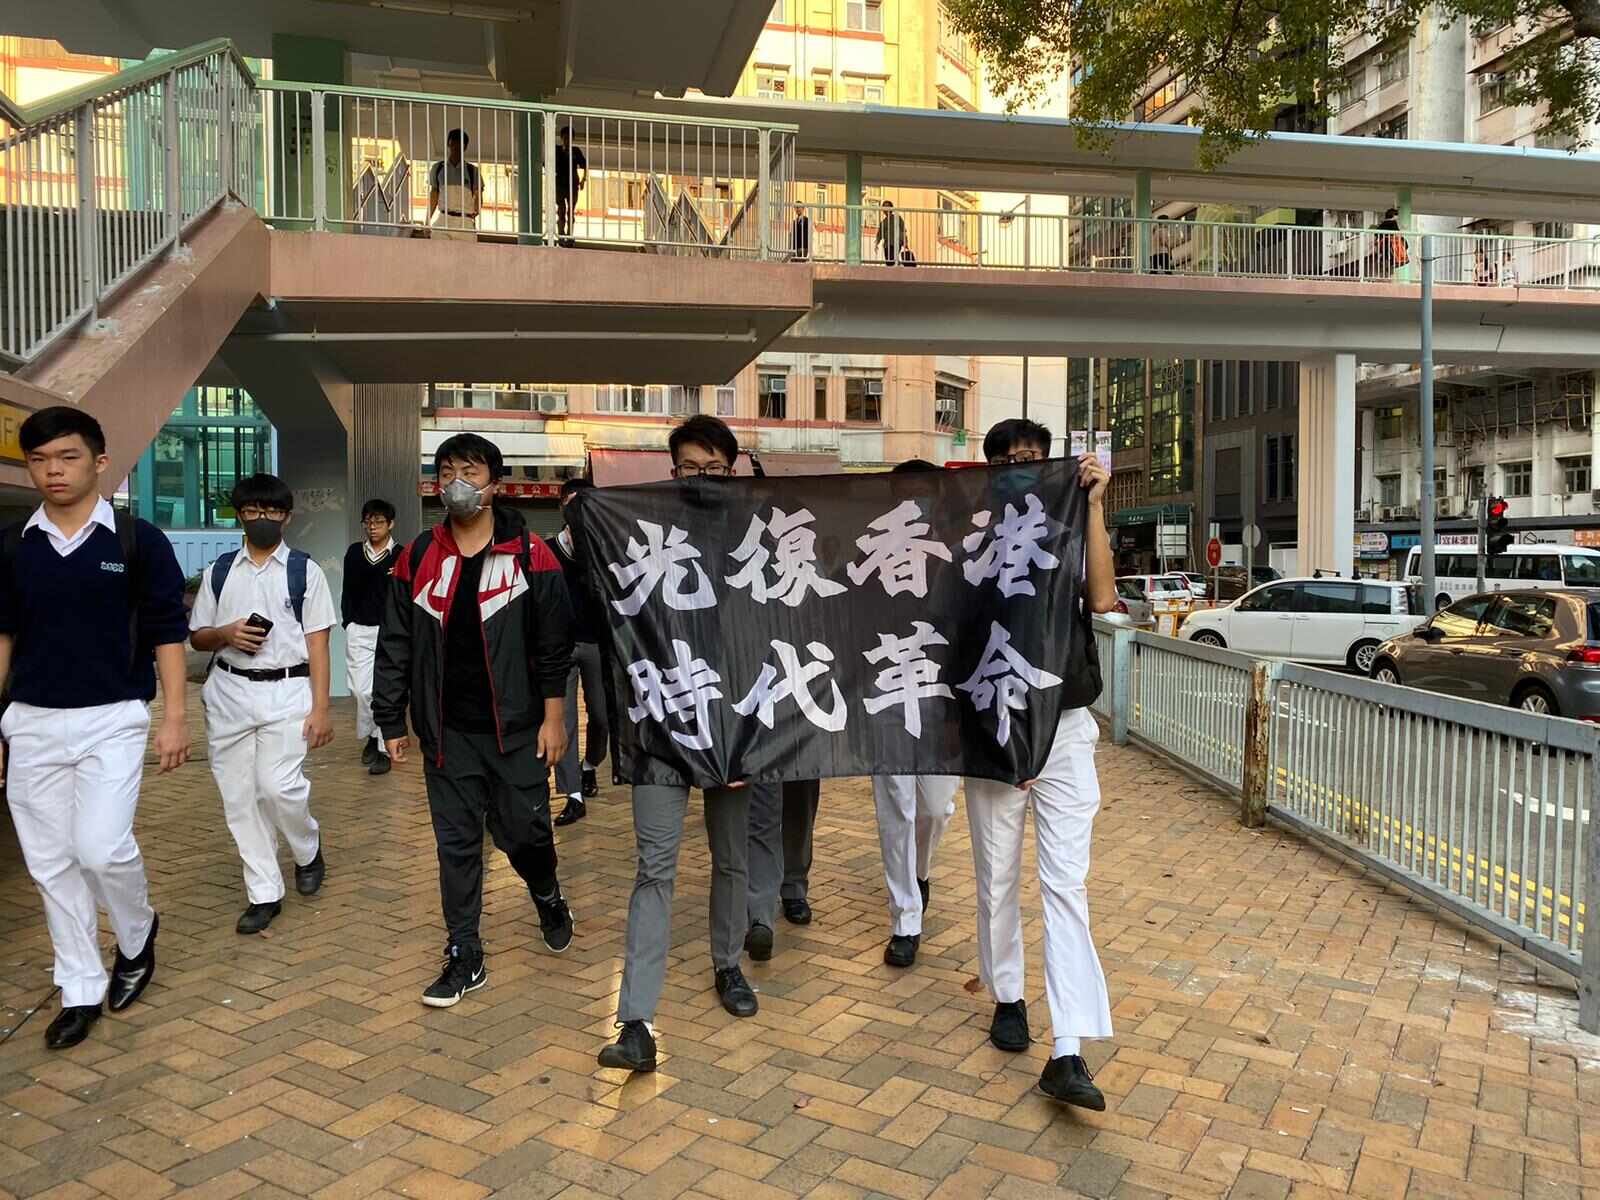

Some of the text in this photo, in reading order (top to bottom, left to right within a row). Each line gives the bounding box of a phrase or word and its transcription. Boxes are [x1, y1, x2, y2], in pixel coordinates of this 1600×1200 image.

[608, 493, 1060, 616] 光復香港
[627, 620, 1063, 750] 時代革命
